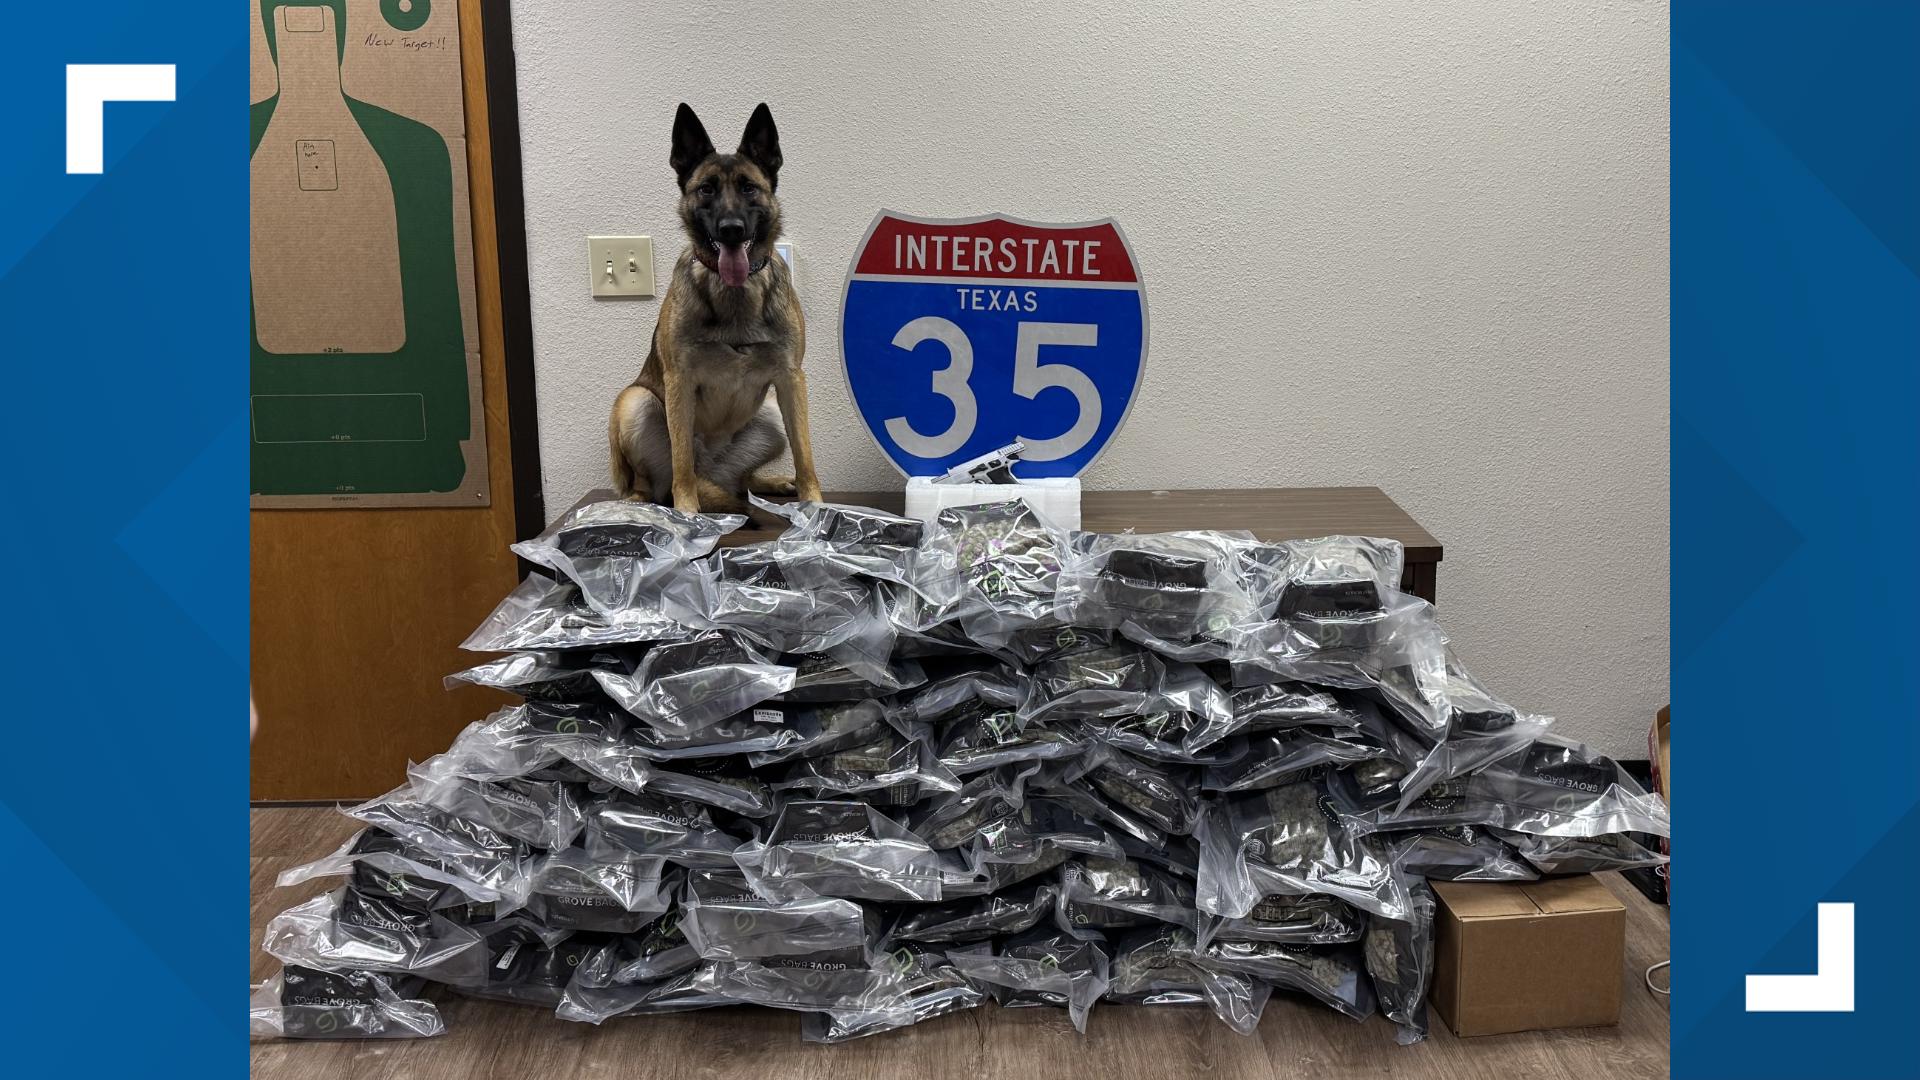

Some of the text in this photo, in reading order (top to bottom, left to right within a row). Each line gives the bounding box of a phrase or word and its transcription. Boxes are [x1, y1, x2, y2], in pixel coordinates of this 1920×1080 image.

[364, 33, 446, 51] New Target!!
[895, 234, 1102, 276] INTERSTATE
[956, 288, 1039, 312] TEXAS
[883, 315, 1103, 462] 35
[1537, 772, 1599, 793] GROVE BAGS
[503, 790, 538, 808] GROVE
[793, 832, 821, 842] BAGS
[558, 896, 594, 906] GROVE
[809, 961, 847, 972] GROVE
[321, 997, 361, 1007] GROVE
